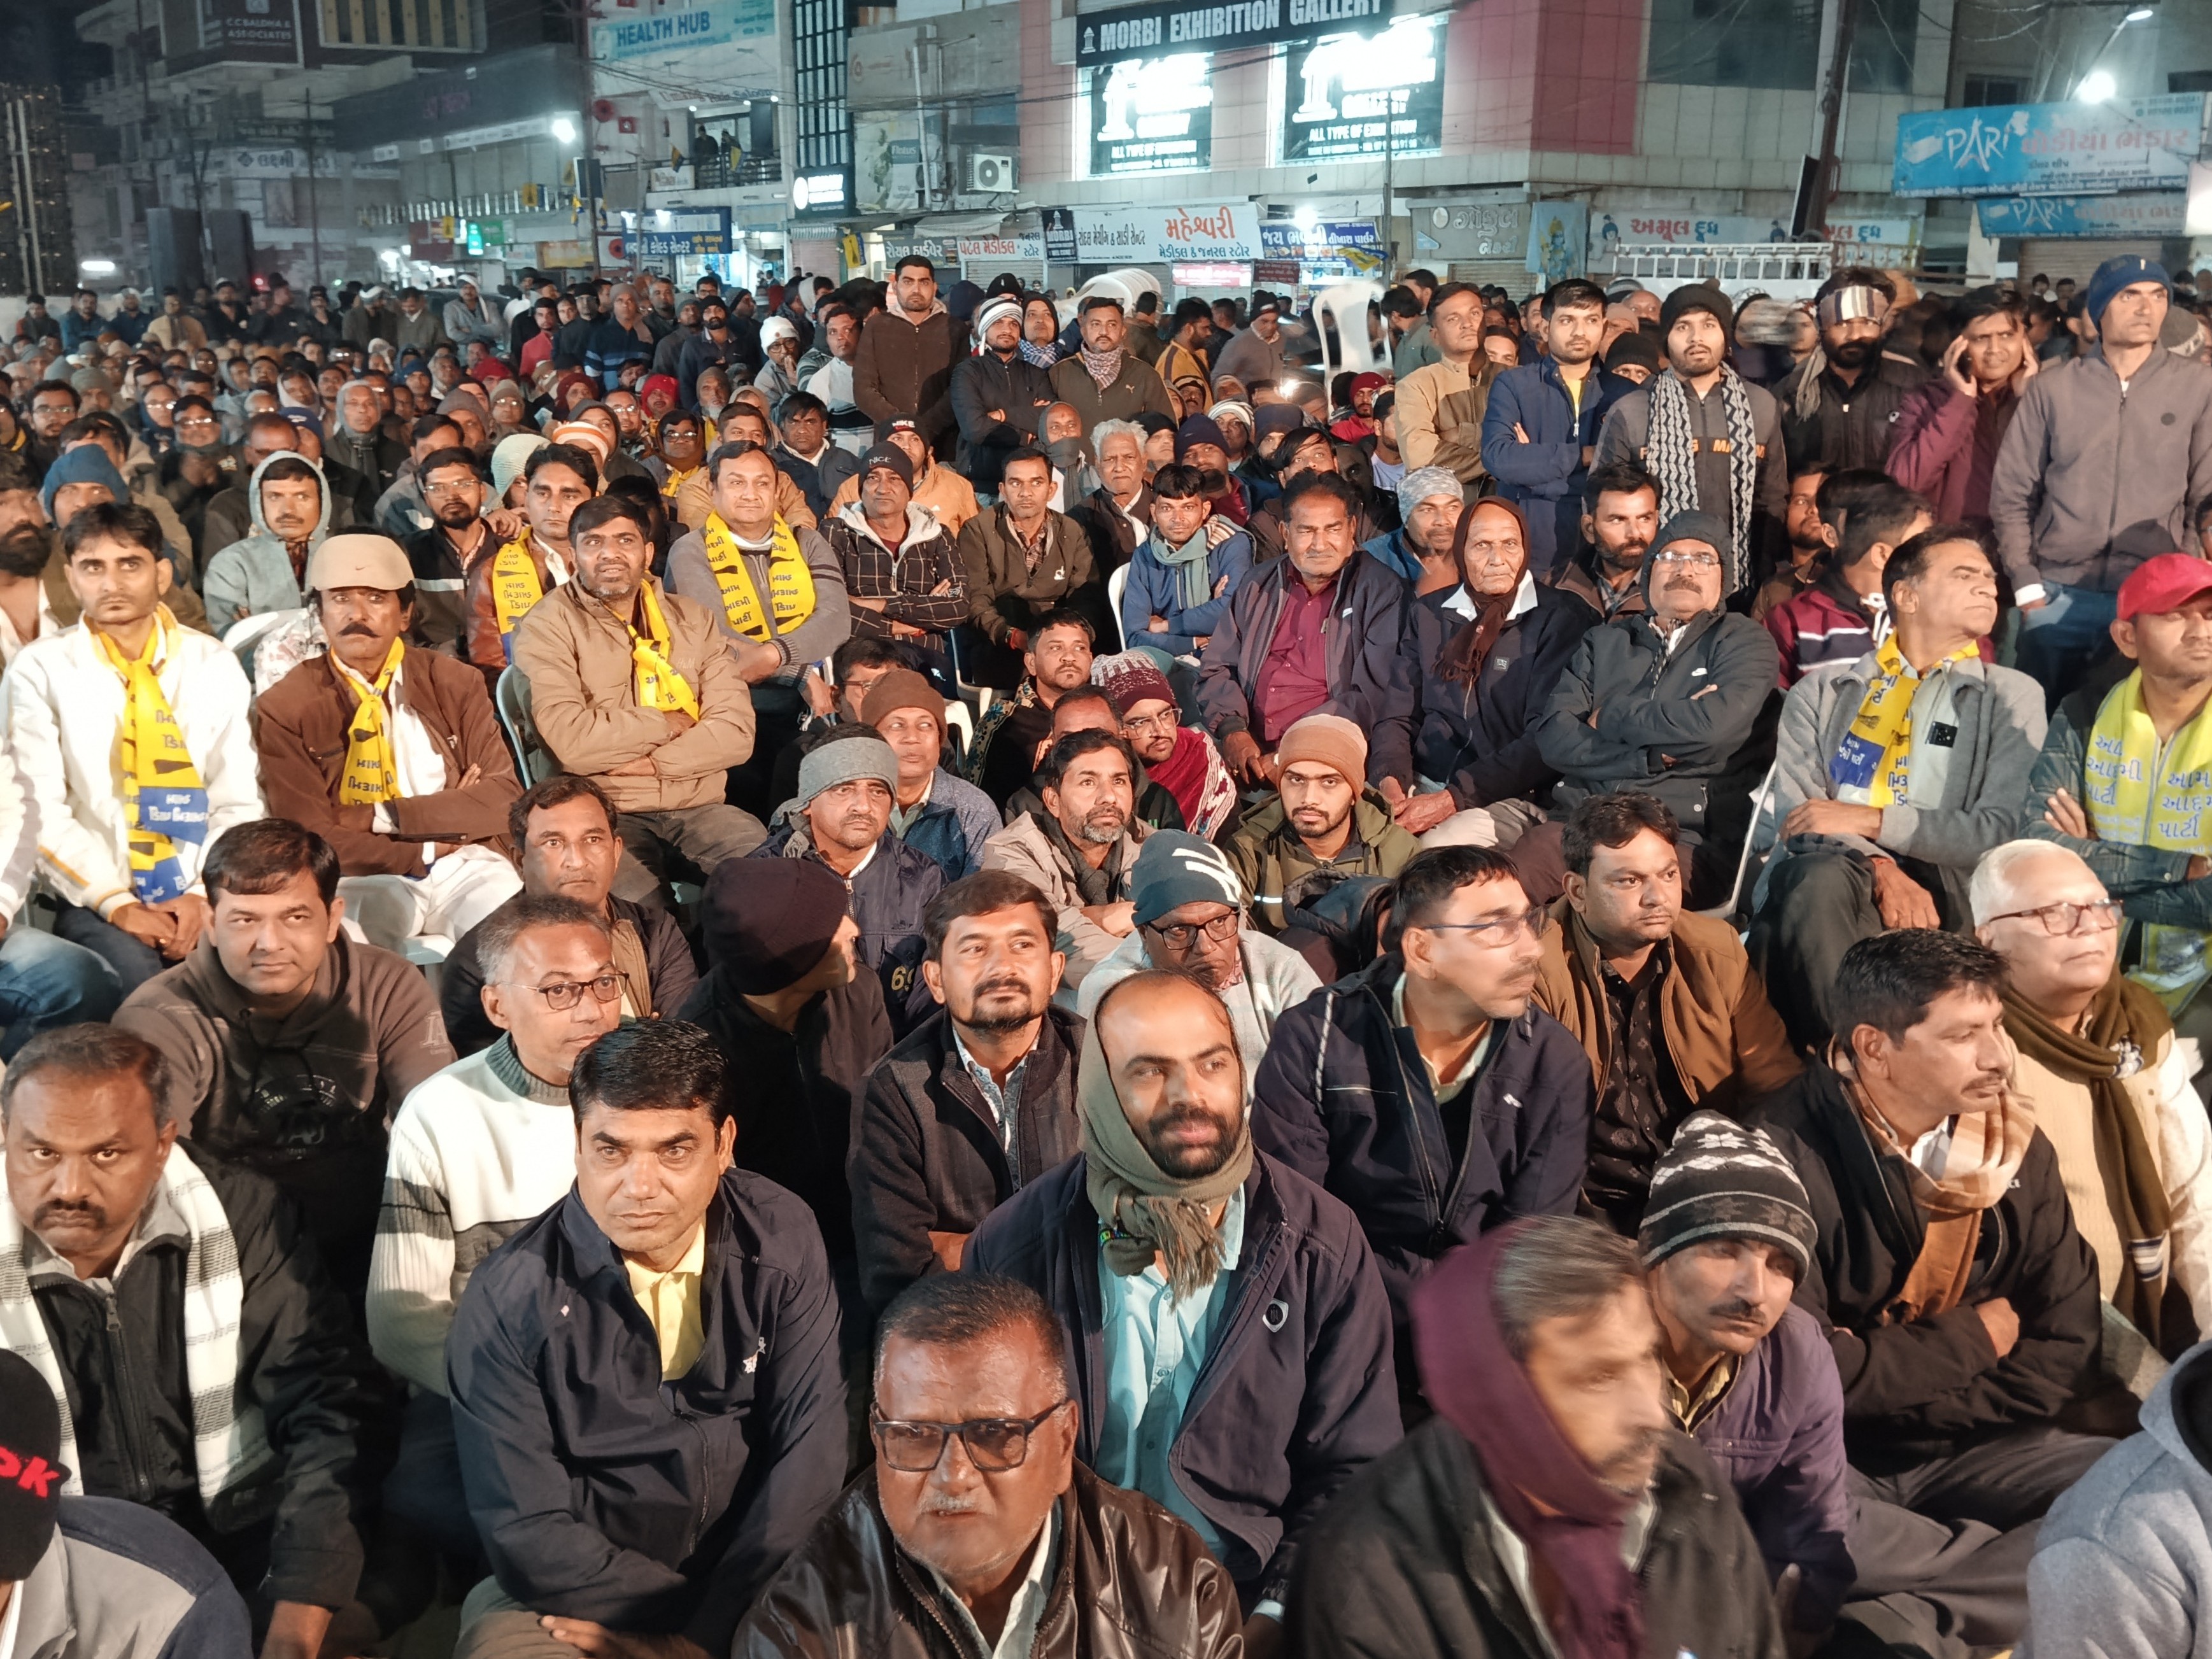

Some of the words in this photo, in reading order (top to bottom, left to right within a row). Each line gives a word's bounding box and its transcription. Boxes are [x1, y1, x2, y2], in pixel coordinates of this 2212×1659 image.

[616, 17, 673, 47] HEALTH
[677, 11, 711, 36] HUB
[1100, 17, 1161, 52] MORBI
[1170, 0, 1280, 43] EXHIBITION
[1165, 205, 1236, 242] મહેશ્વરી
[1631, 218, 1690, 243] અમૂલ
[1694, 220, 1719, 243] દૂધ
[960, 236, 981, 255] પટેલ
[984, 233, 1016, 255] મેડીકલ
[1019, 232, 1041, 241] જનરલ
[1046, 230, 1074, 242] MORBI
[1262, 230, 1284, 246] જય
[886, 241, 911, 258] રોયલ
[912, 239, 943, 257] હાર્ડવેર
[1023, 244, 1040, 257] સ્ટોર
[1158, 243, 1188, 258] મેડીકલ
[1190, 246, 1197, 258] &
[1198, 245, 1226, 257] જનરલ
[1229, 242, 1251, 257] સ્ટોર
[868, 456, 891, 465] NICE
[2167, 772, 2210, 789] આમ
[2162, 795, 2212, 812] આદ
[2159, 812, 2199, 838] પાર્ટી
